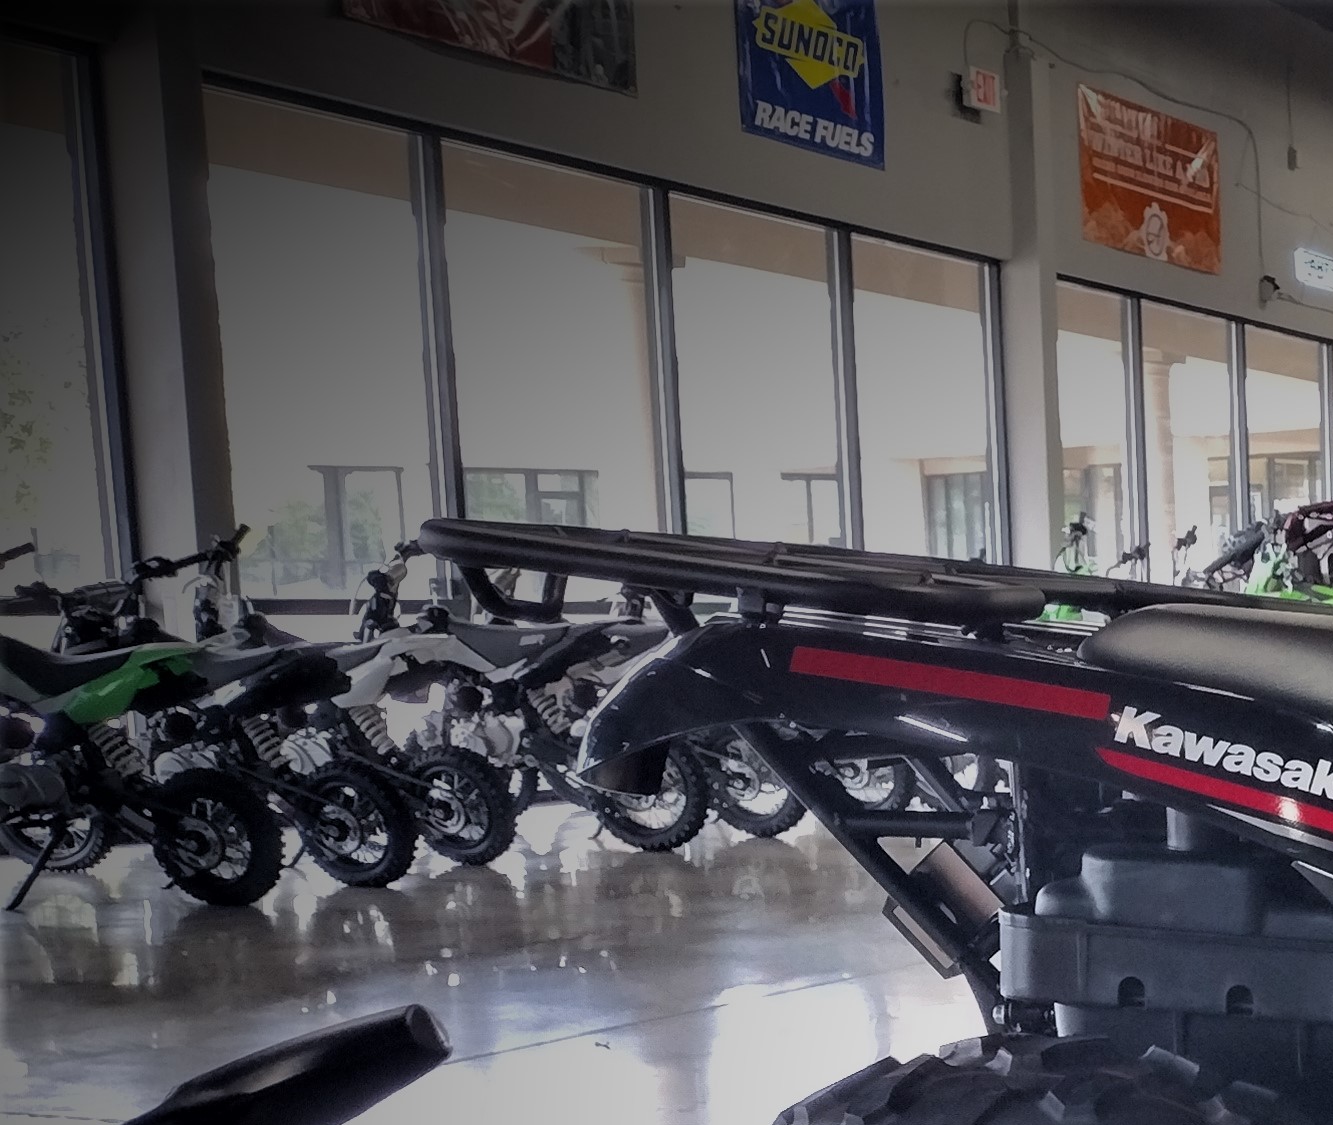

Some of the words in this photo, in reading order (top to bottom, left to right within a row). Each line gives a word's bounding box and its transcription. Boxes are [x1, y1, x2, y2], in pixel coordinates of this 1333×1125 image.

[762, 12, 860, 73] SUNOCO
[754, 101, 814, 139] RACE
[814, 118, 875, 158] FUELS
